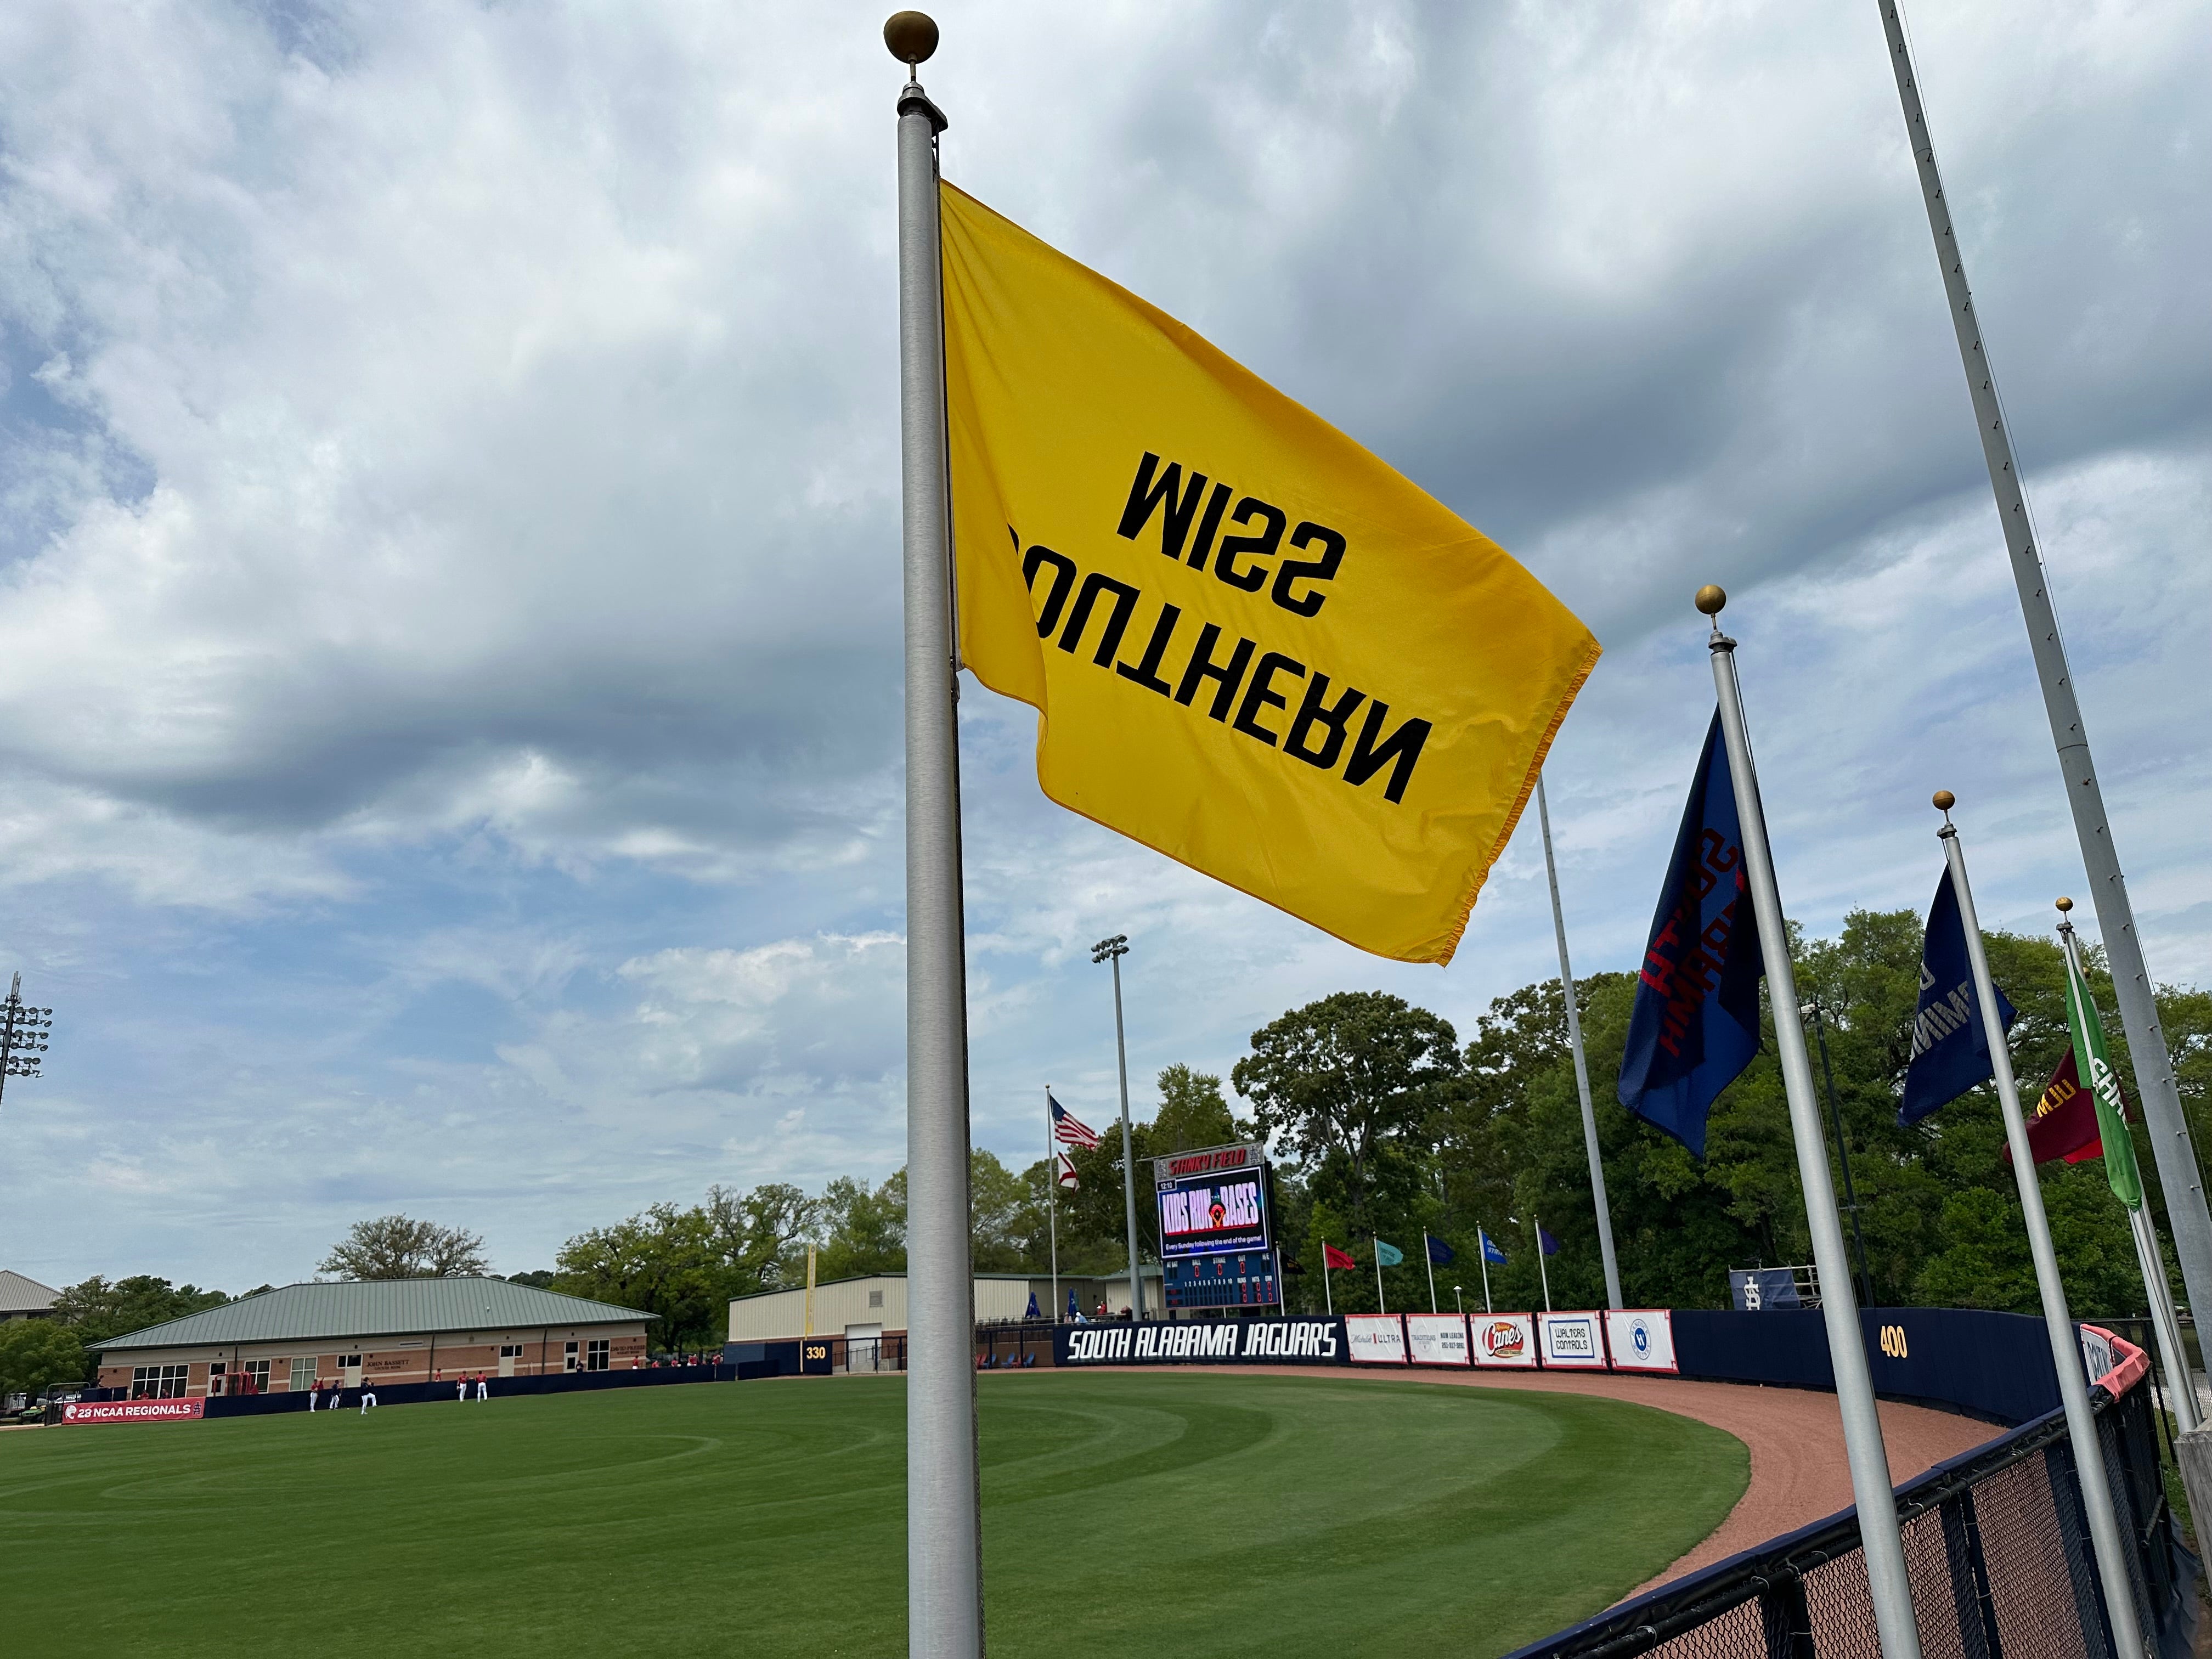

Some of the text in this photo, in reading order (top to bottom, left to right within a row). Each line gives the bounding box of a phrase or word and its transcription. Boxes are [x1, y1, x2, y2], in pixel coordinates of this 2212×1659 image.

[1168, 1154, 1211, 1175] STANKY
[1212, 1148, 1246, 1168] FIELD
[1162, 1192, 1189, 1233] KIDS
[1188, 1188, 1214, 1231] RUN
[1220, 1182, 1259, 1227] BASES
[1378, 1334, 1401, 1343] ULTRA
[1555, 1328, 1585, 1338] WALTERS
[1068, 1322, 1337, 1359] SOUTH ALABAMA JAGUARS
[1556, 1340, 1587, 1350] CONTROLS
[1881, 1325, 1908, 1358] 400
[806, 1346, 826, 1359] 330
[77, 1408, 91, 1418] 28
[93, 1407, 123, 1417] NCAA
[126, 1404, 191, 1416] REGIONALS
